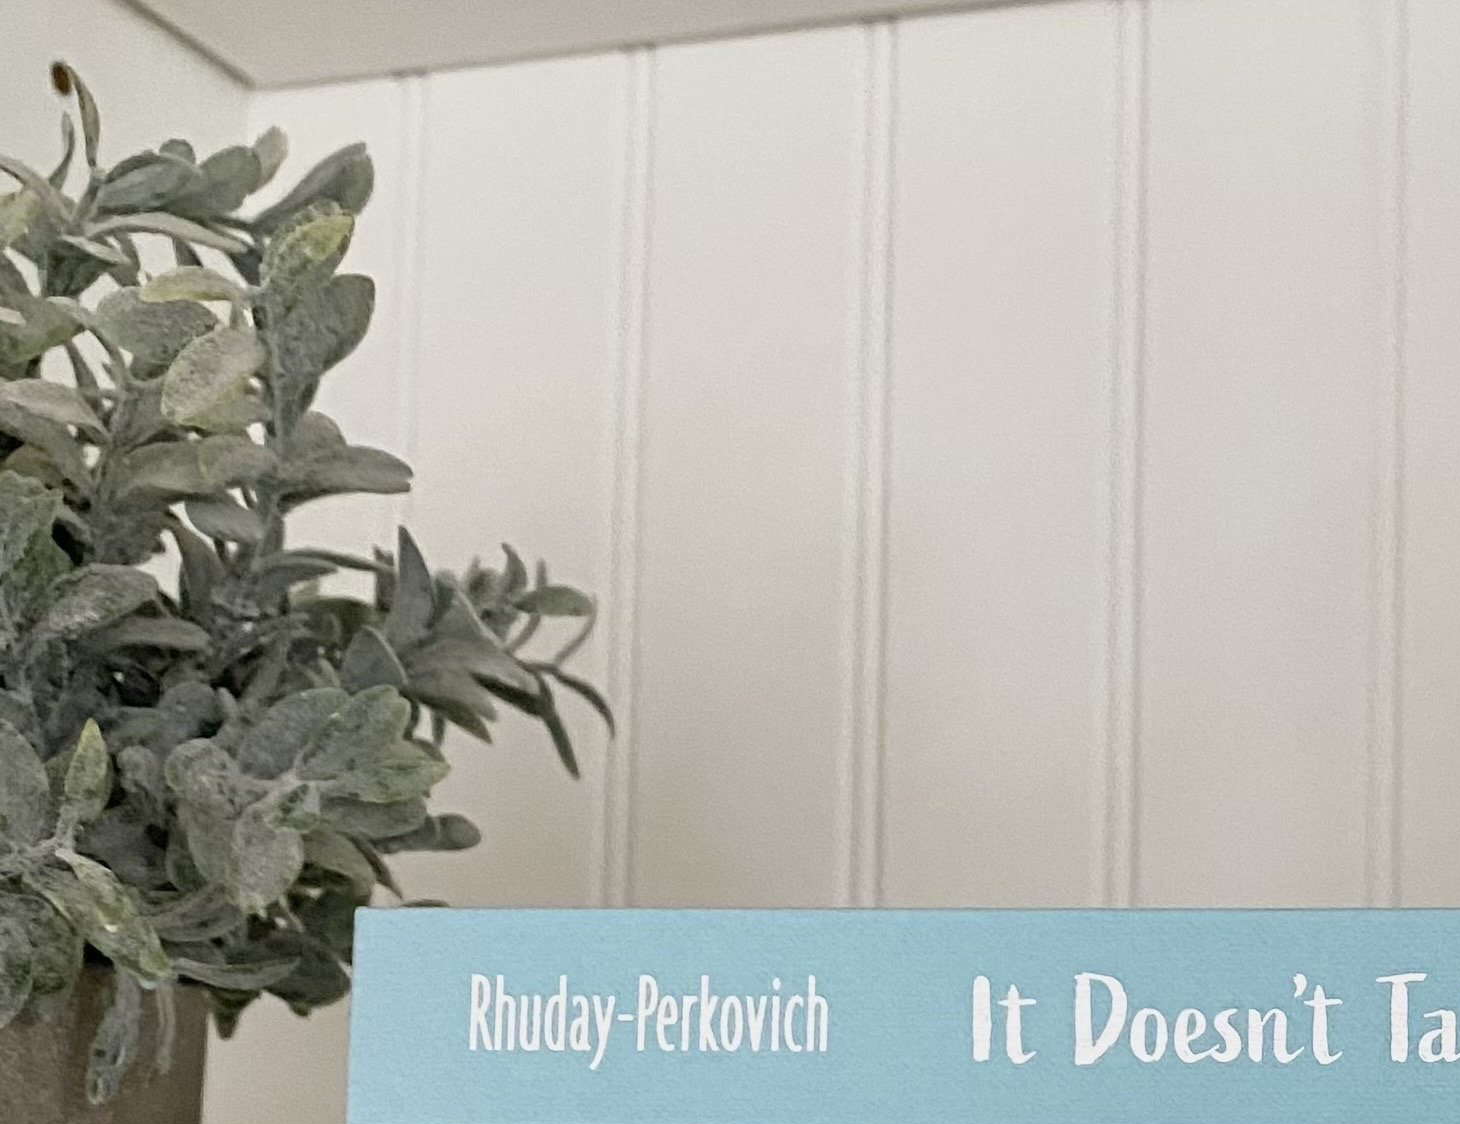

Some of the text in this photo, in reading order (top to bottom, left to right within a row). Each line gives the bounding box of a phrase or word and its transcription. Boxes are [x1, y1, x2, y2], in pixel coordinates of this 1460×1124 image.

[468, 972, 829, 1071] Rhuday-Perkovich
[972, 971, 1037, 1066] It
[1074, 970, 1344, 1068] Doesn't
